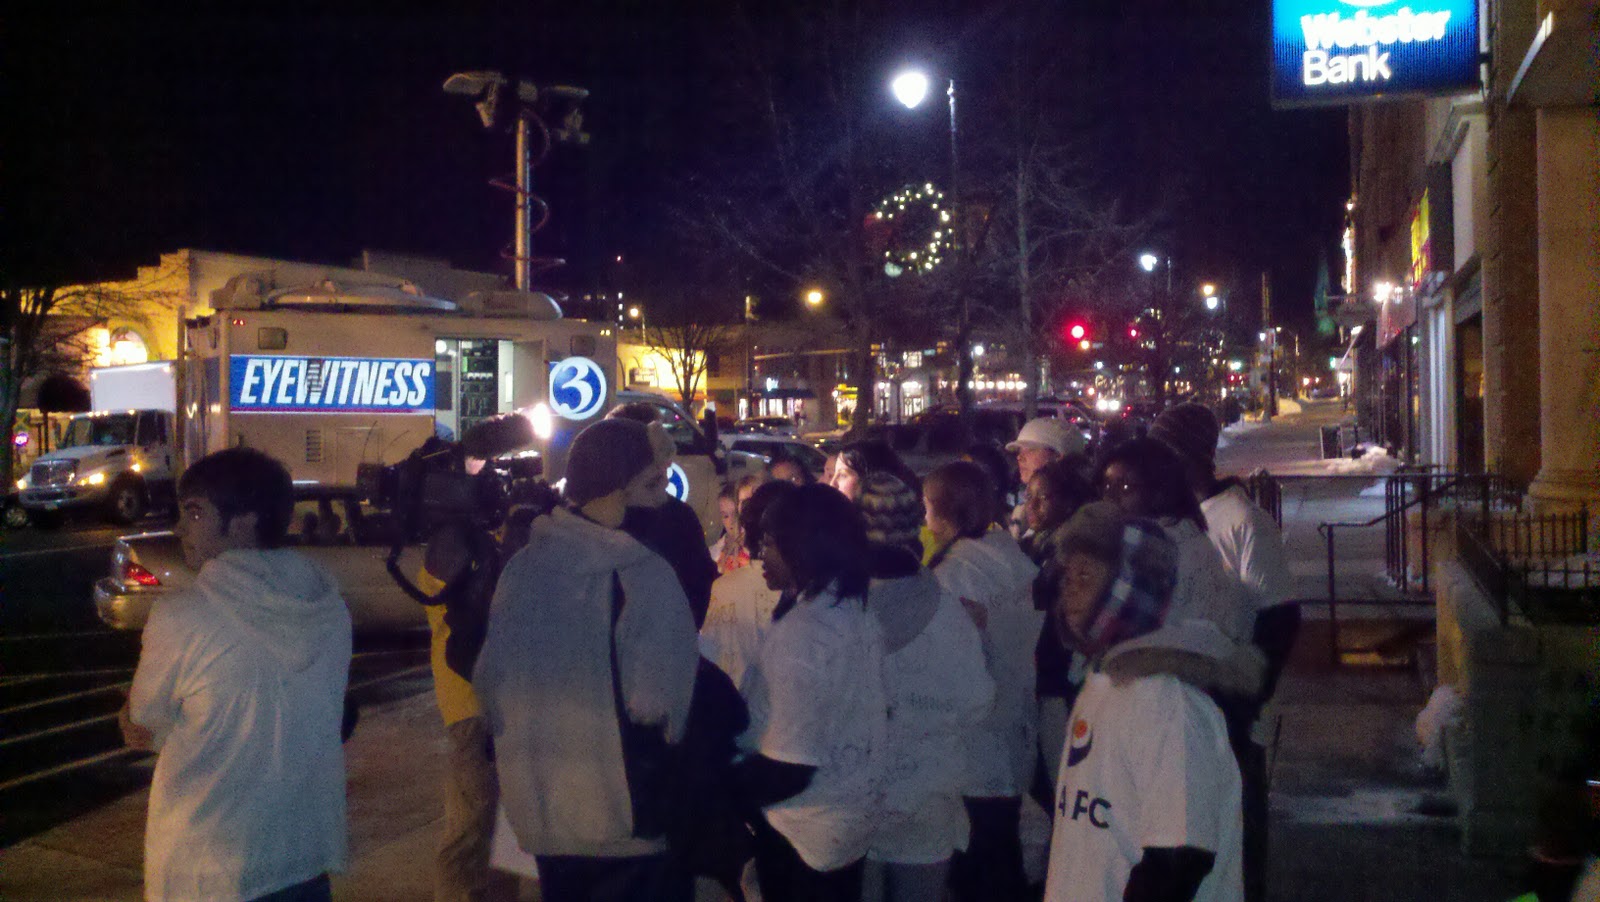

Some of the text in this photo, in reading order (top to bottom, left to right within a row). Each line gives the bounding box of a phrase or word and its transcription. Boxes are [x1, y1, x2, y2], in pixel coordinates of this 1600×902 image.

[1301, 7, 1450, 49] Webster
[1303, 46, 1391, 85] Bank
[240, 358, 430, 406] EYEWITNESS
[555, 360, 595, 414] 3
